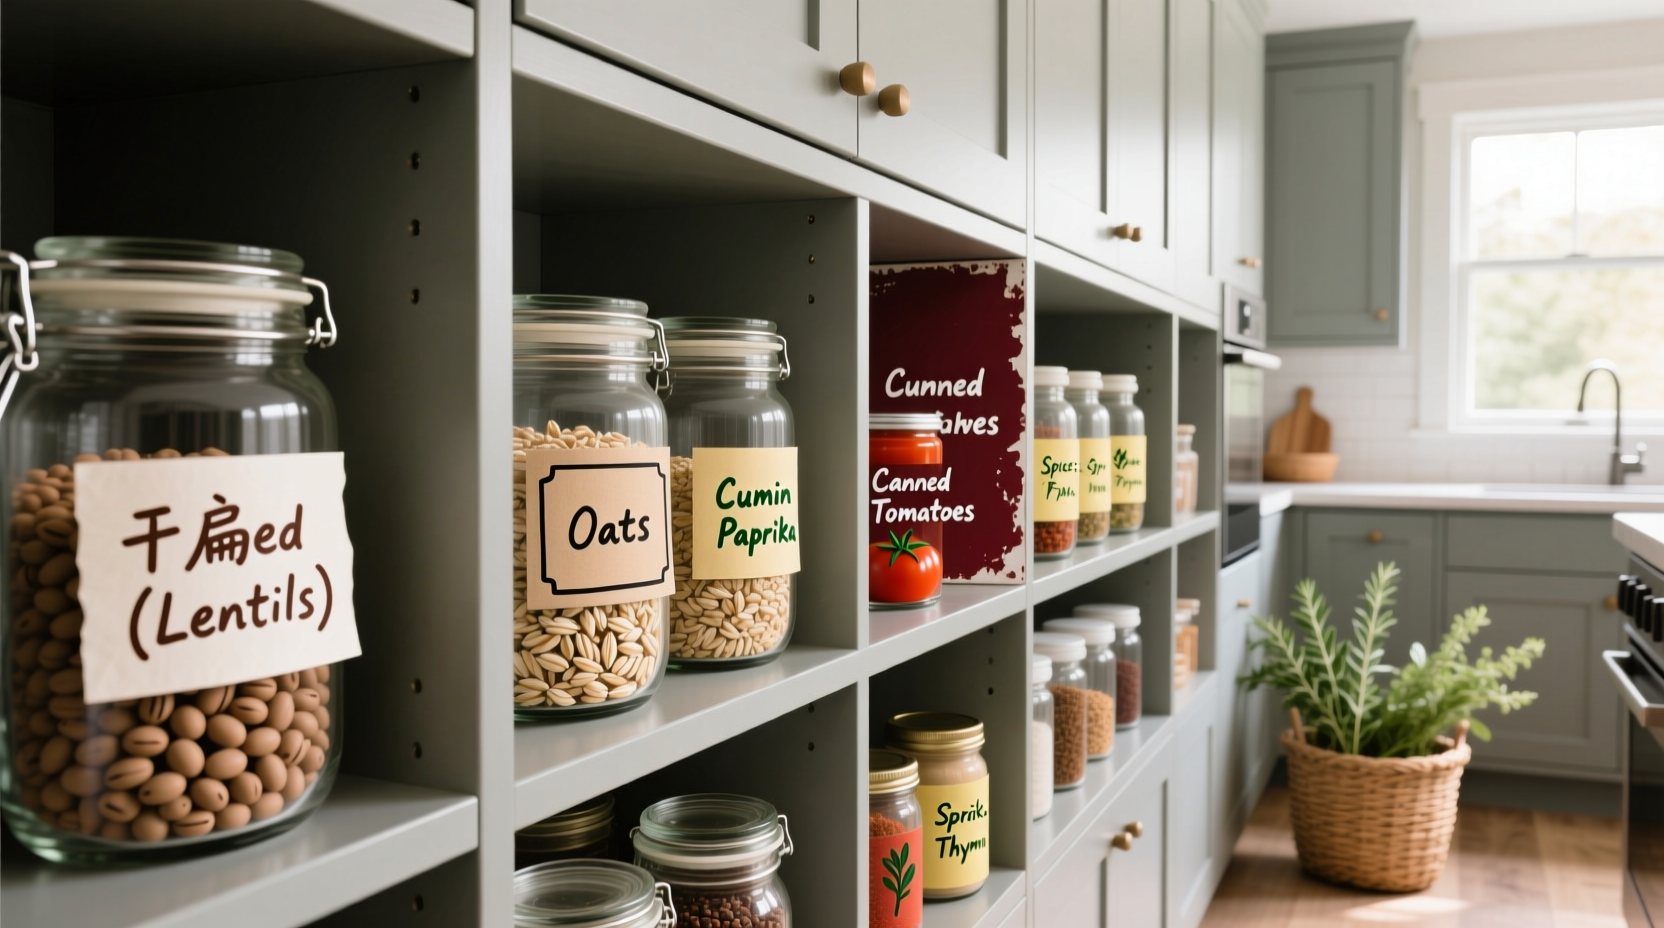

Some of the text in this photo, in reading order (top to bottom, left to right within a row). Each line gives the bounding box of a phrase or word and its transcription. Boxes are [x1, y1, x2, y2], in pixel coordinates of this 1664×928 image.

[885, 367, 985, 398] Cunned
[715, 476, 792, 510] Cumin
[872, 467, 952, 493] Canned
[568, 505, 650, 550] Oats
[871, 498, 975, 524] Tomatoes
[717, 516, 797, 557] Paprika
[129, 563, 333, 662] (Lentils)
